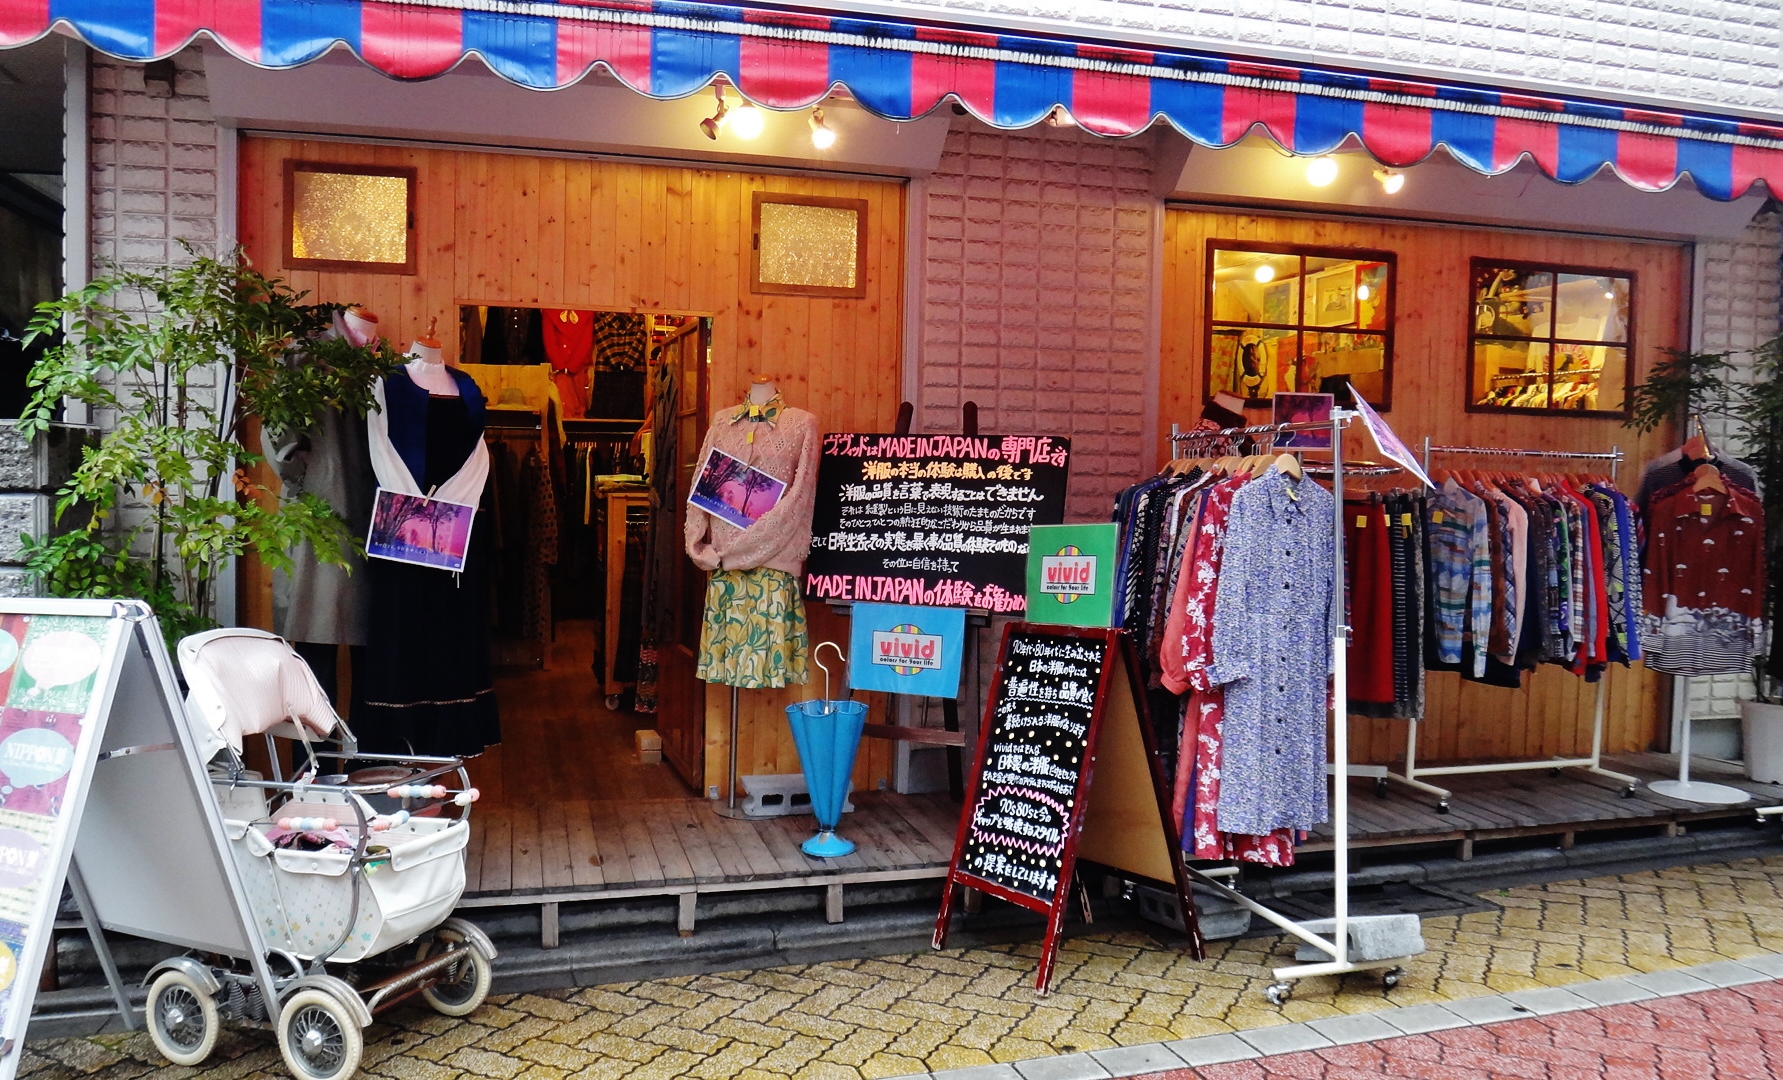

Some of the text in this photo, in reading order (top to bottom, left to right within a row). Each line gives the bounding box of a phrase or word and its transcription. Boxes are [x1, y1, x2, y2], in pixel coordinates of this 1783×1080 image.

[1046, 561, 1091, 583] vivid
[880, 637, 935, 660] vivid
[923, 659, 934, 667] life
